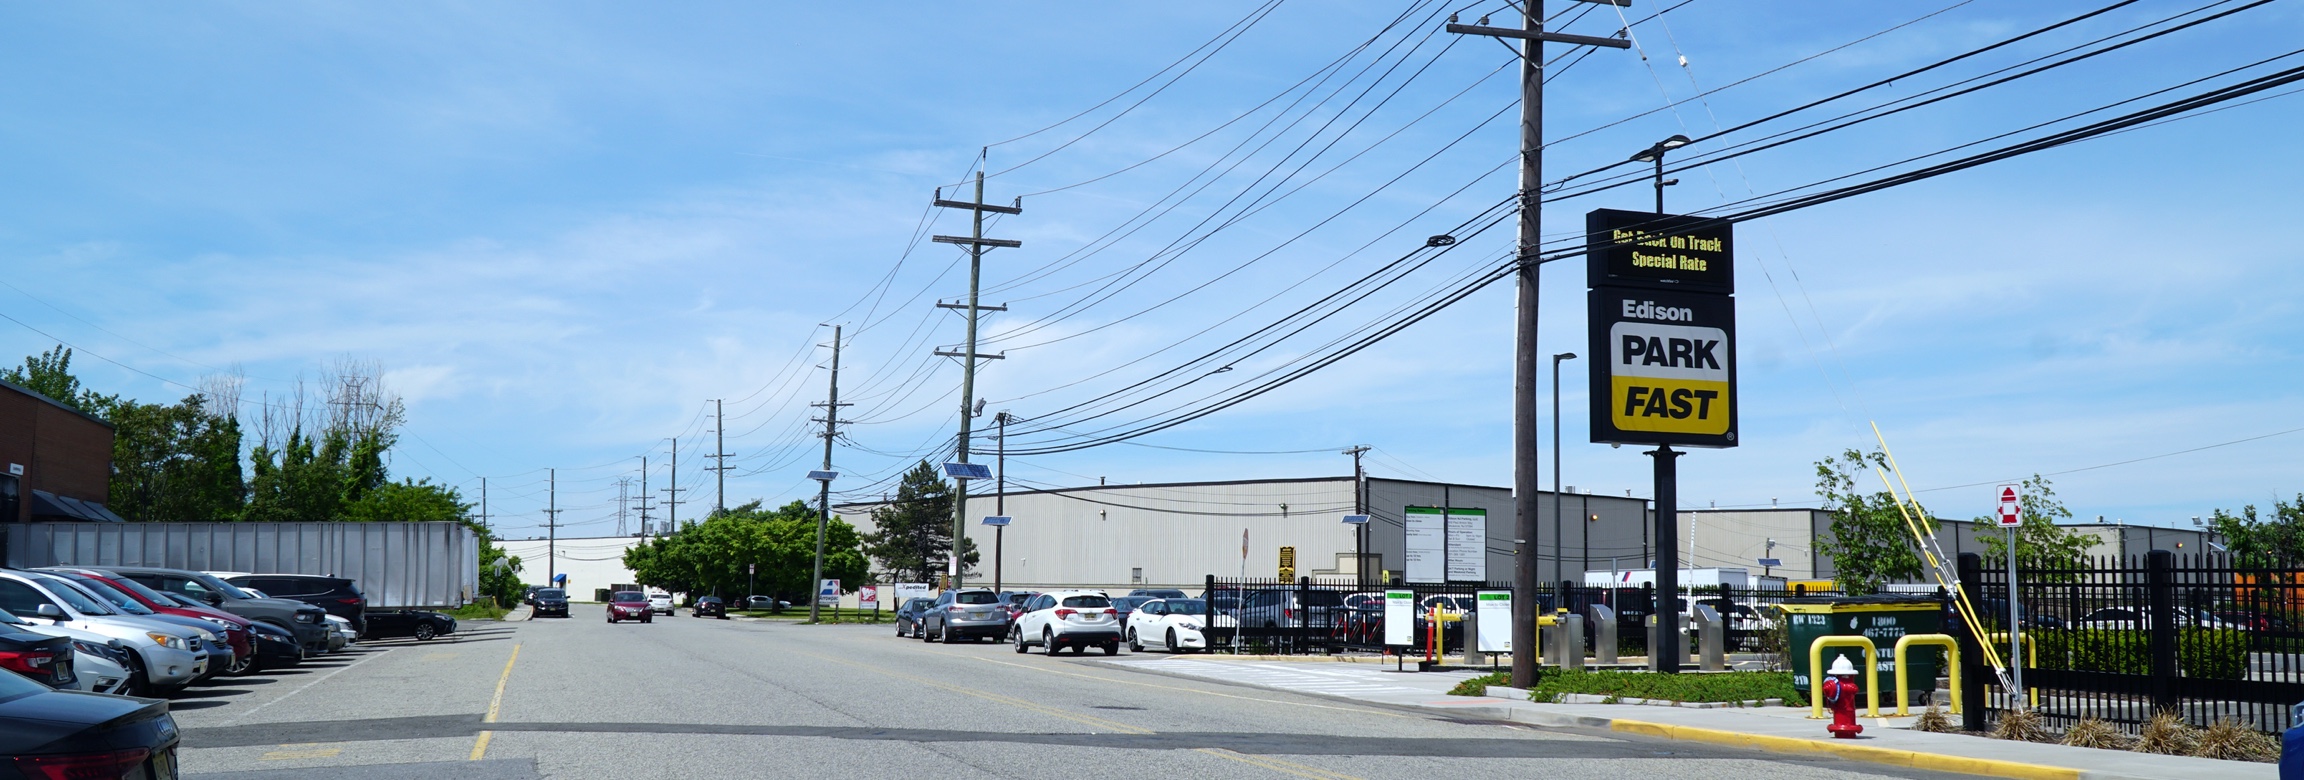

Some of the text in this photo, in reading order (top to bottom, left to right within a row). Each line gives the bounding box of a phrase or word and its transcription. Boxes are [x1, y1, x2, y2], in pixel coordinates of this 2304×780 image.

[1670, 235, 1685, 249] On
[1687, 235, 1722, 253] Track
[1632, 251, 1707, 272] Special Rate
[1622, 299, 1693, 322] Edison
[1622, 334, 1721, 370] PARK
[1624, 386, 1718, 420] FAST
[1862, 627, 1906, 638] 467-7775
